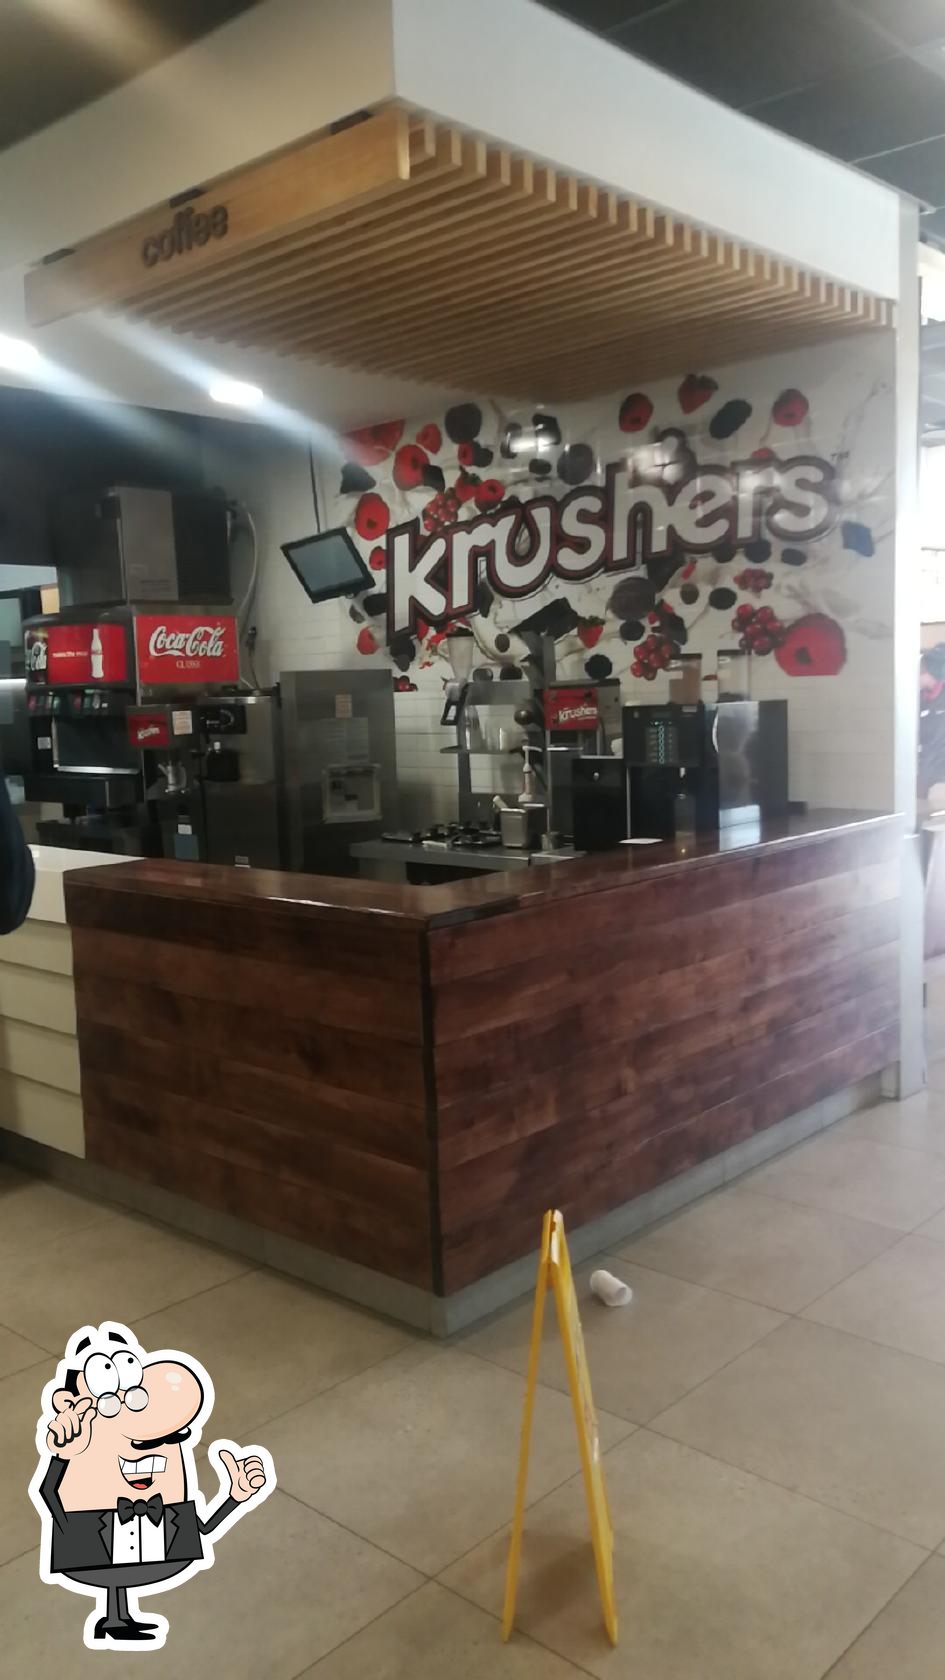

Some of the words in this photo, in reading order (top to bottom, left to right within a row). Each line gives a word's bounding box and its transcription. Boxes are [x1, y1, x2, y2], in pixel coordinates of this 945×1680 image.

[142, 205, 229, 267] coffee
[388, 457, 836, 640] krushers
[148, 625, 226, 657] Coca-Cola
